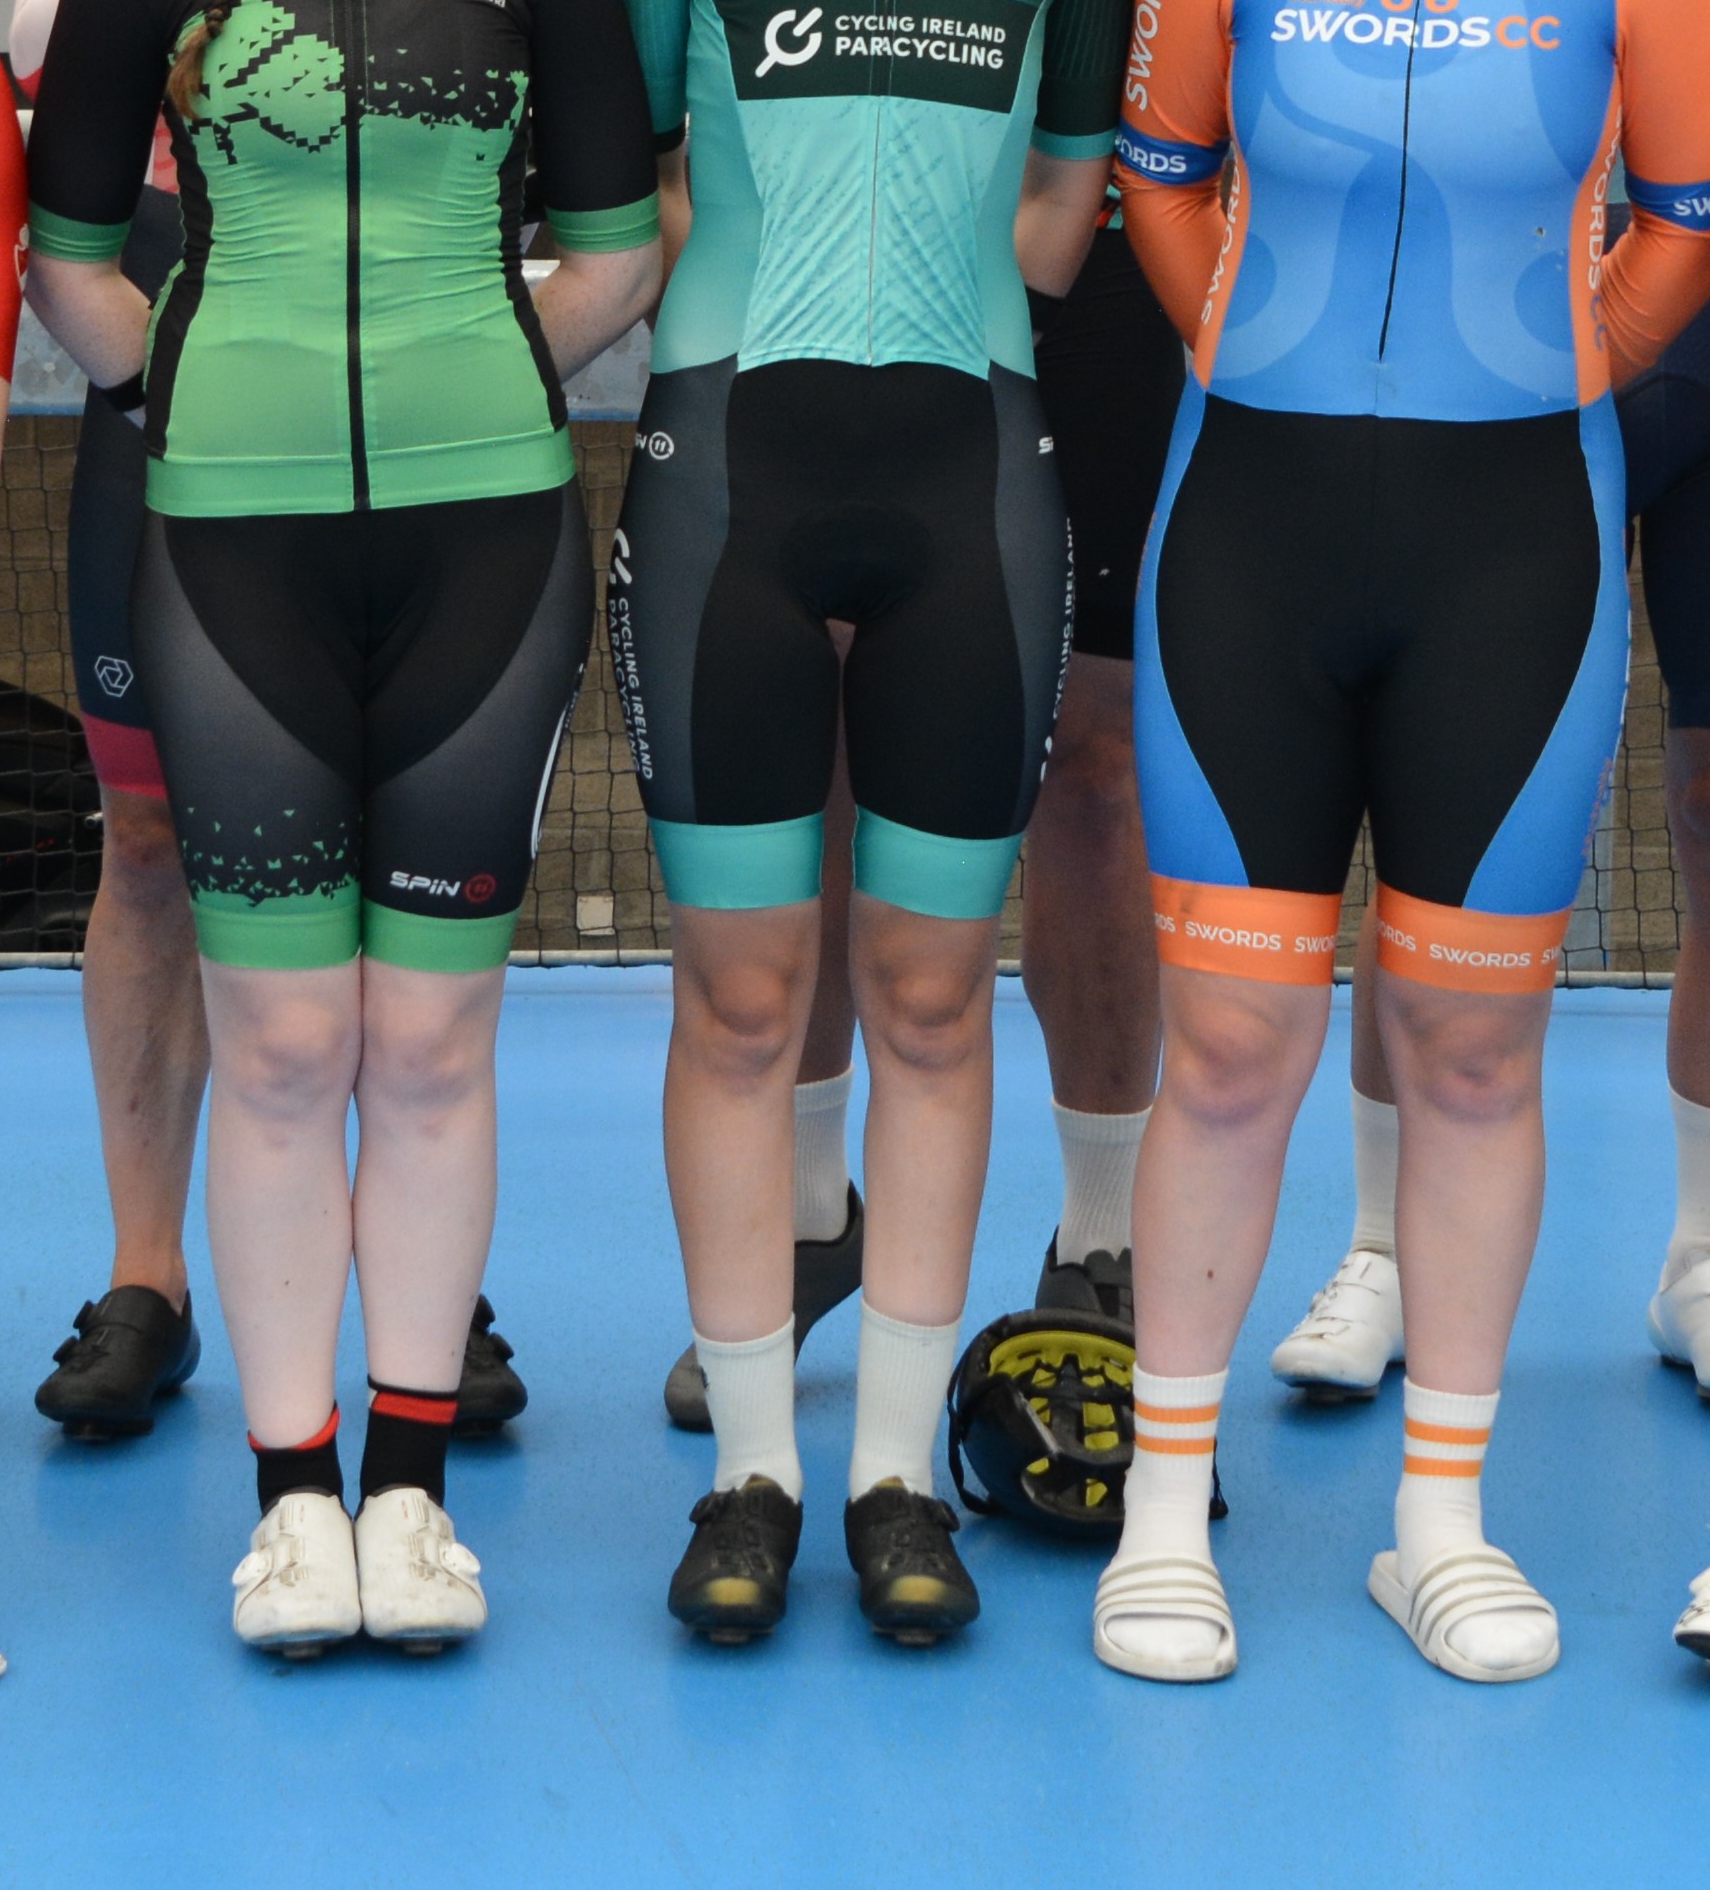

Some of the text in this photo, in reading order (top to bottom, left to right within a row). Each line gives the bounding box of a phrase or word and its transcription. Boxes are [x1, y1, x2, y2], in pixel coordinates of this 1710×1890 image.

[835, 15, 1007, 44] CYCLNG IRELAND
[834, 35, 1005, 70] PARACYCLING
[1184, 921, 1283, 952] SWORDS
[1429, 942, 1532, 968] SWORDS
